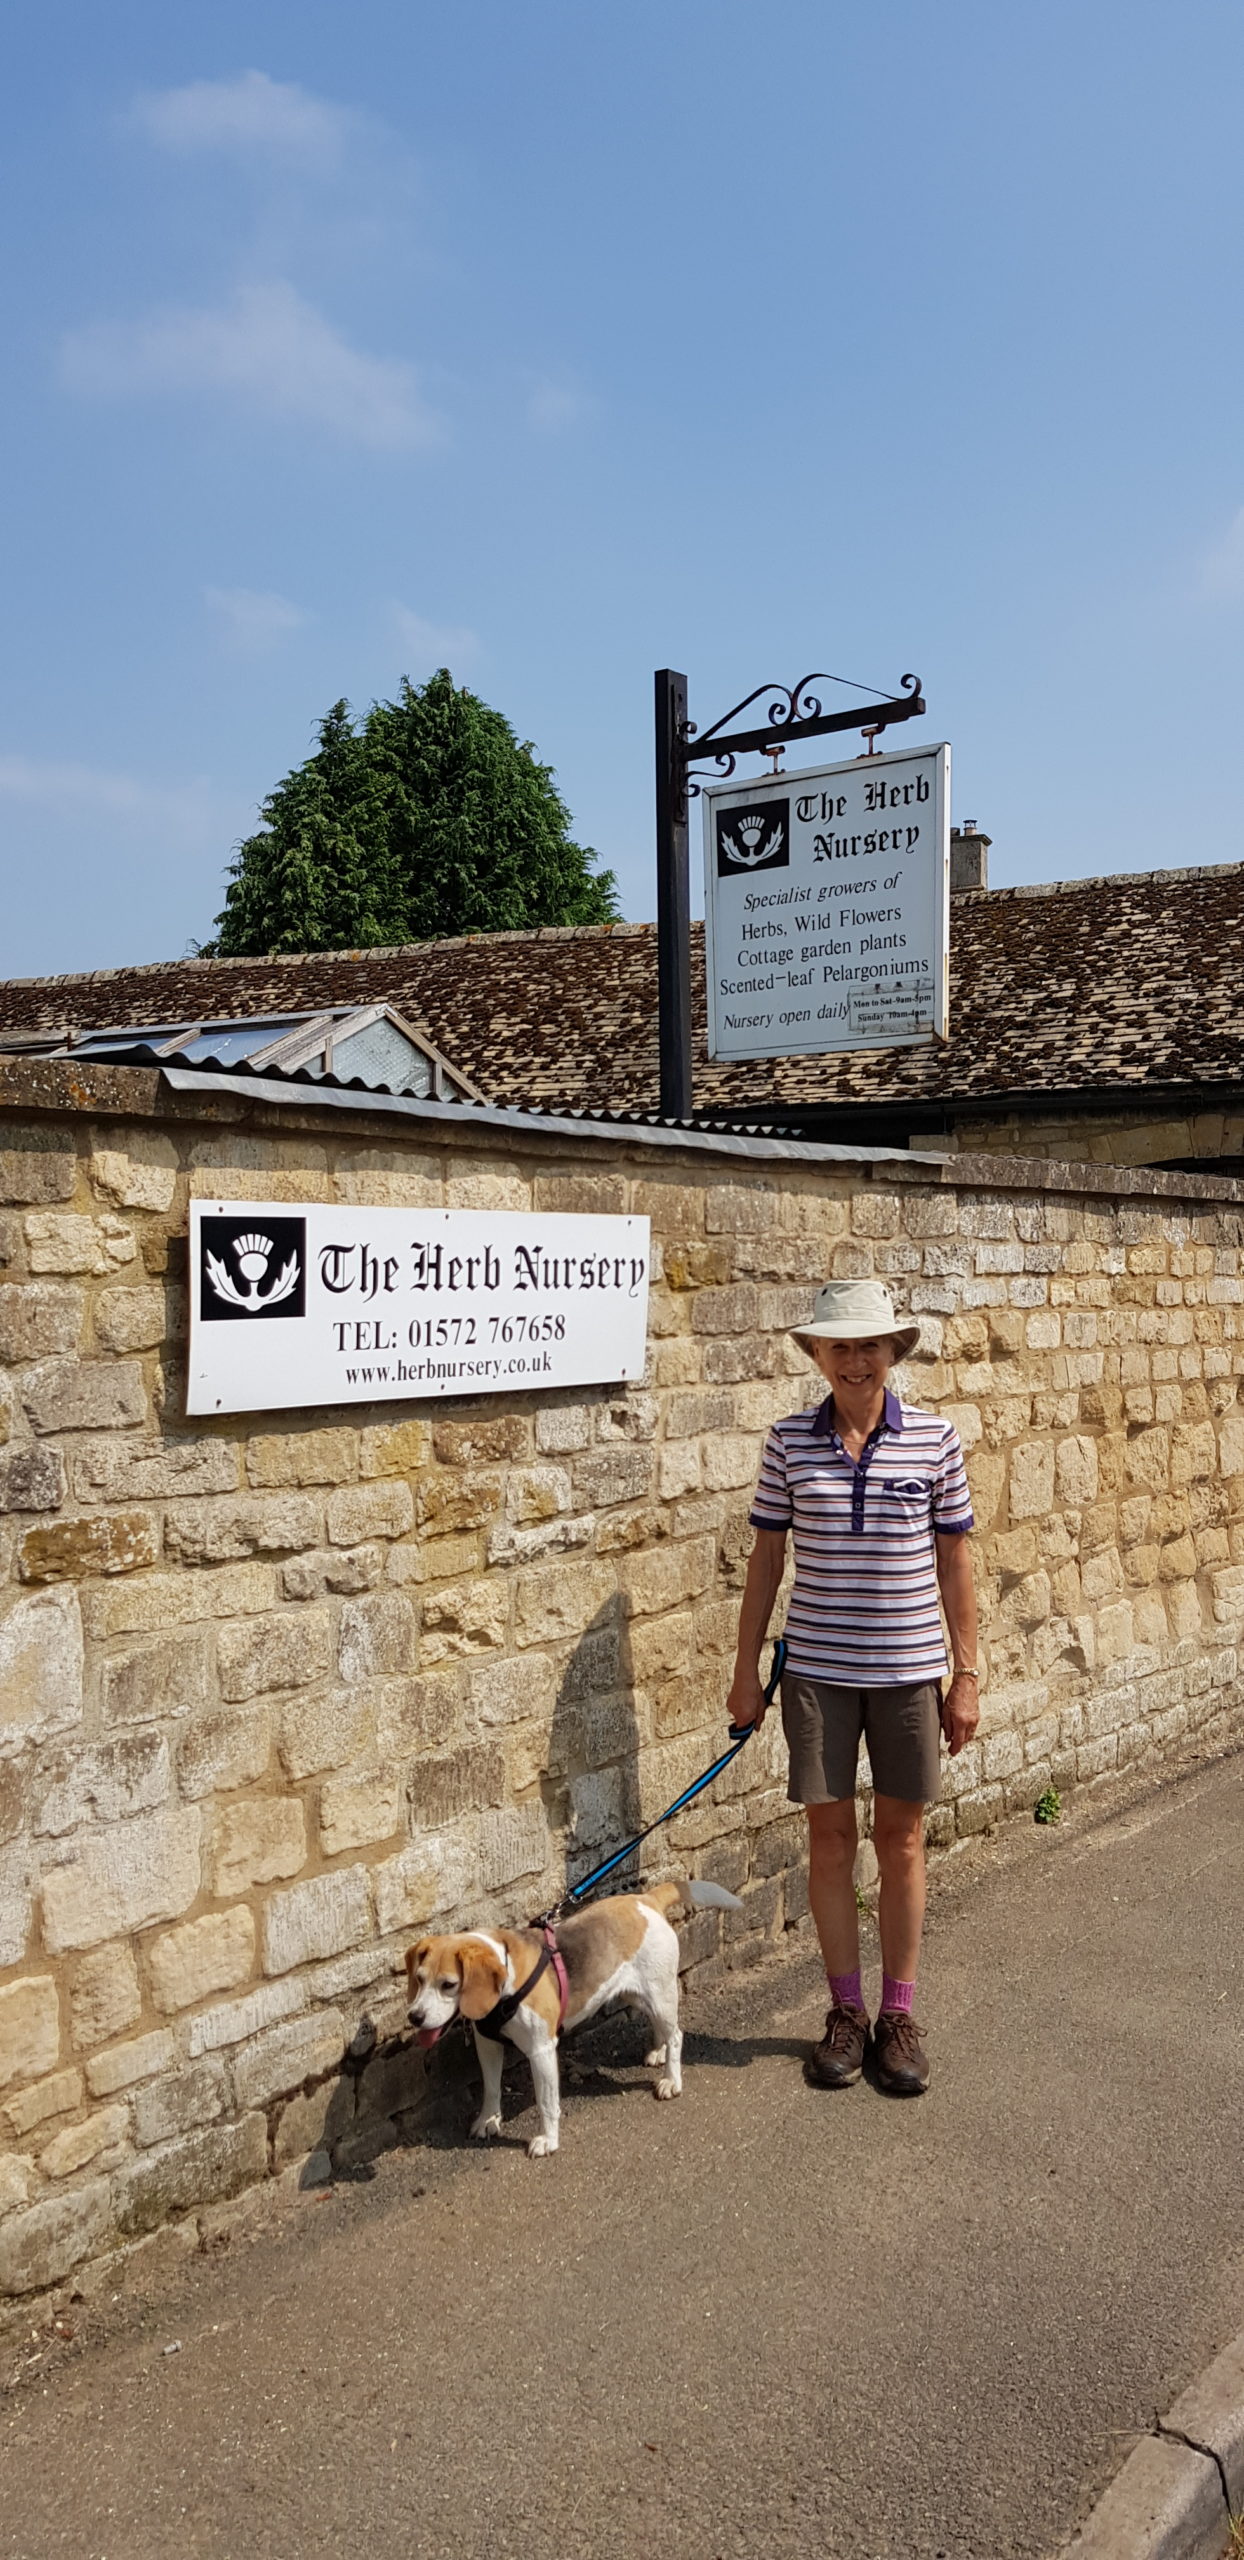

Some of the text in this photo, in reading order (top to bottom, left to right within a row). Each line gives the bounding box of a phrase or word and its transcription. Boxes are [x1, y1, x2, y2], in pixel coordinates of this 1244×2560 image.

[795, 773, 930, 826] The Herb
[813, 824, 920, 863] Nursery
[743, 871, 903, 912] Specialist growers of
[741, 905, 902, 941] Herbs, Wild Flowers
[737, 931, 907, 968] Cottage garden plants
[823, 957, 929, 983] Pelargoniums
[723, 1001, 850, 1030] Nursery open daily
[853, 1000, 870, 1009] Mon
[871, 999, 879, 1007] to
[858, 1013, 884, 1022] Sunday
[318, 1242, 645, 1303] The Herb Nursery
[333, 1314, 566, 1352] TEL: 01572 767658
[345, 1351, 553, 1385] www.herbnursery.co.uk
